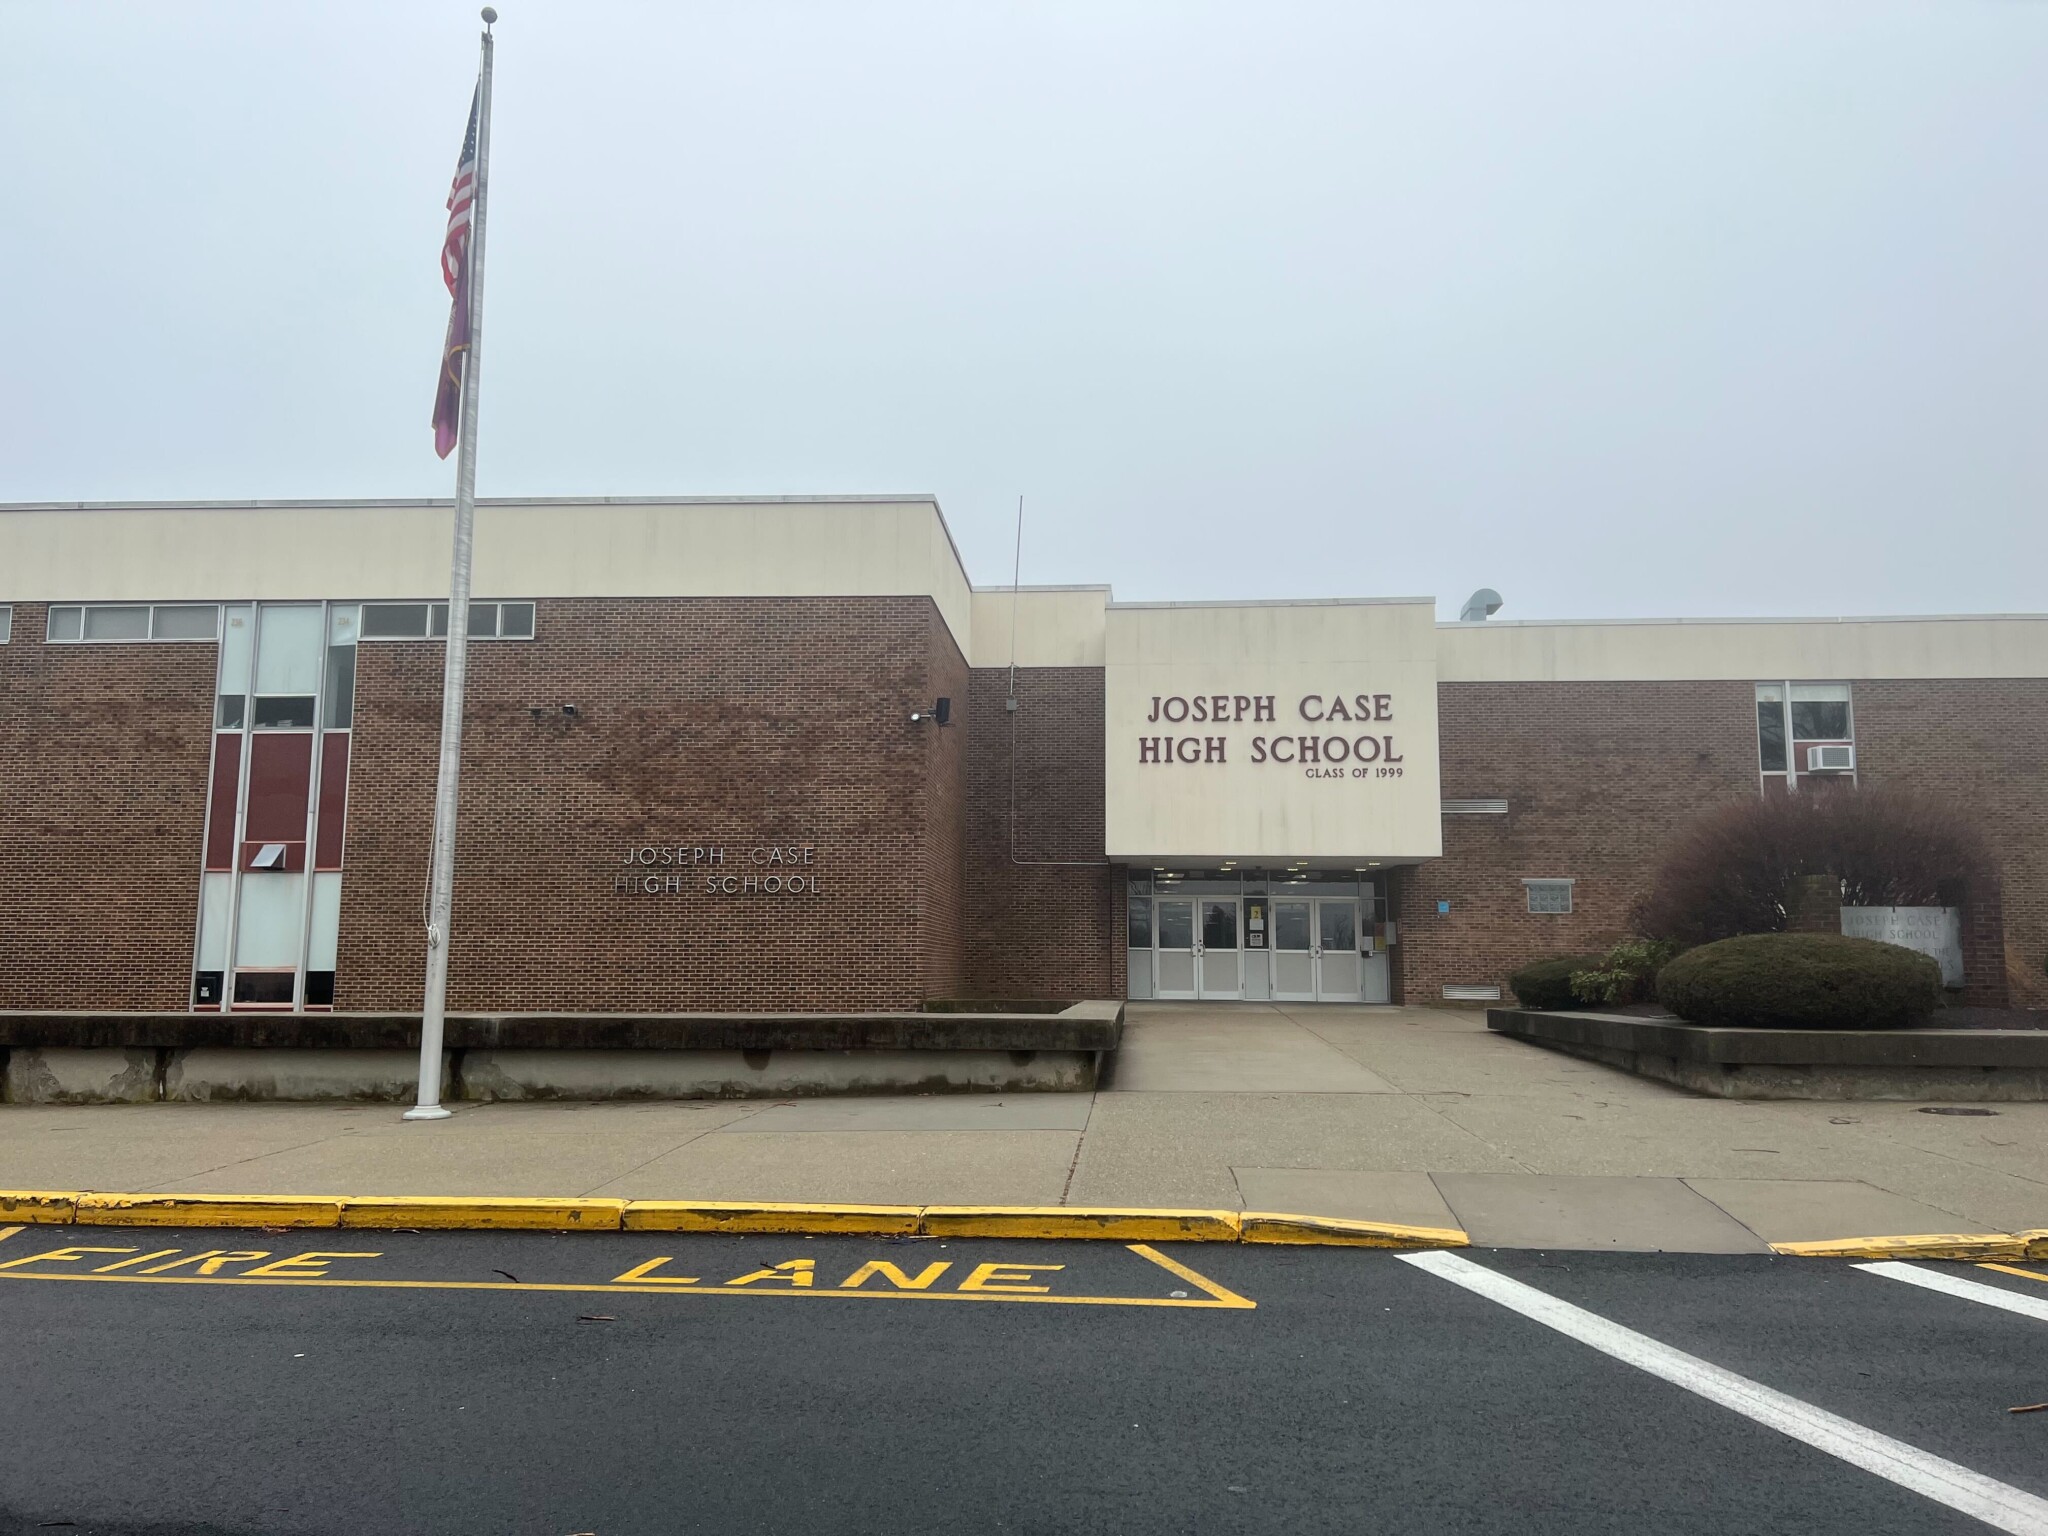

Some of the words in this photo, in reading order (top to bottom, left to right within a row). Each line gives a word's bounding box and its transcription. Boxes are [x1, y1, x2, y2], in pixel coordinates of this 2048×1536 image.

[1148, 696, 1276, 723] JOSEPH
[1299, 694, 1393, 721] CASE
[1139, 737, 1227, 763] HIGH
[1251, 736, 1404, 763] SCHOOL
[1305, 768, 1345, 778] CLASS
[1352, 768, 1369, 778] OF
[1375, 767, 1404, 778] 1999
[623, 847, 724, 865] JOSEPH
[751, 847, 815, 865] CASE
[615, 876, 680, 894] HIGH
[706, 876, 821, 894] SCHOOL
[1254, 910, 1258, 918] 2
[1850, 915, 1899, 926] JOSEPH
[1907, 915, 1941, 926] CASE
[1852, 929, 1882, 939] HIGH
[1890, 929, 1939, 939] SCHOOL
[1932, 947, 1952, 956] THE
[0, 1247, 384, 1277] FIRE
[610, 1257, 1066, 1293] LANE
